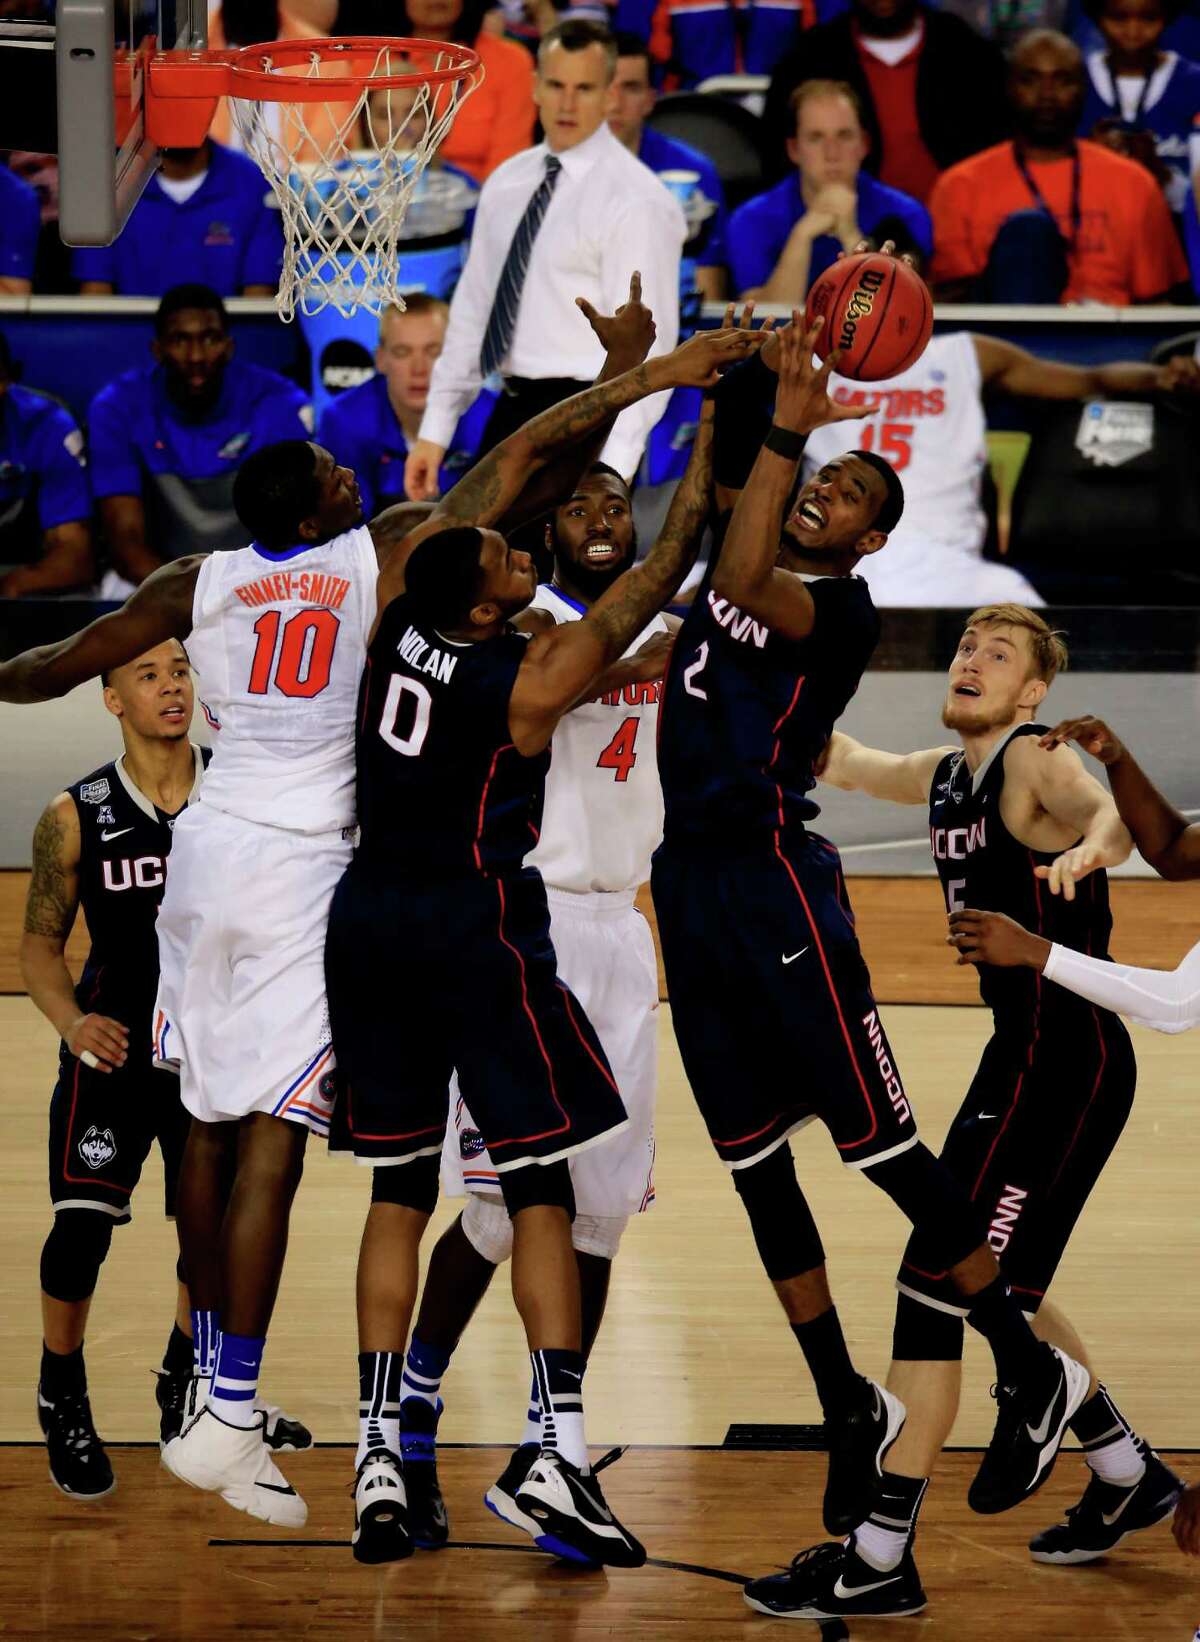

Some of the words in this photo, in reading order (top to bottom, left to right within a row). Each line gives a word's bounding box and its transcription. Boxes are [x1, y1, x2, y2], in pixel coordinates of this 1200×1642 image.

[839, 269, 886, 350] Wilson
[861, 424, 915, 473] 15
[234, 571, 351, 609] FINNEY-SMITH
[247, 608, 341, 699] 10
[396, 624, 458, 685] NOLAN
[683, 640, 710, 701] 2
[378, 672, 433, 757] 0
[596, 716, 641, 782] 4
[103, 856, 166, 892] UC
[862, 1009, 911, 1125] UCONN
